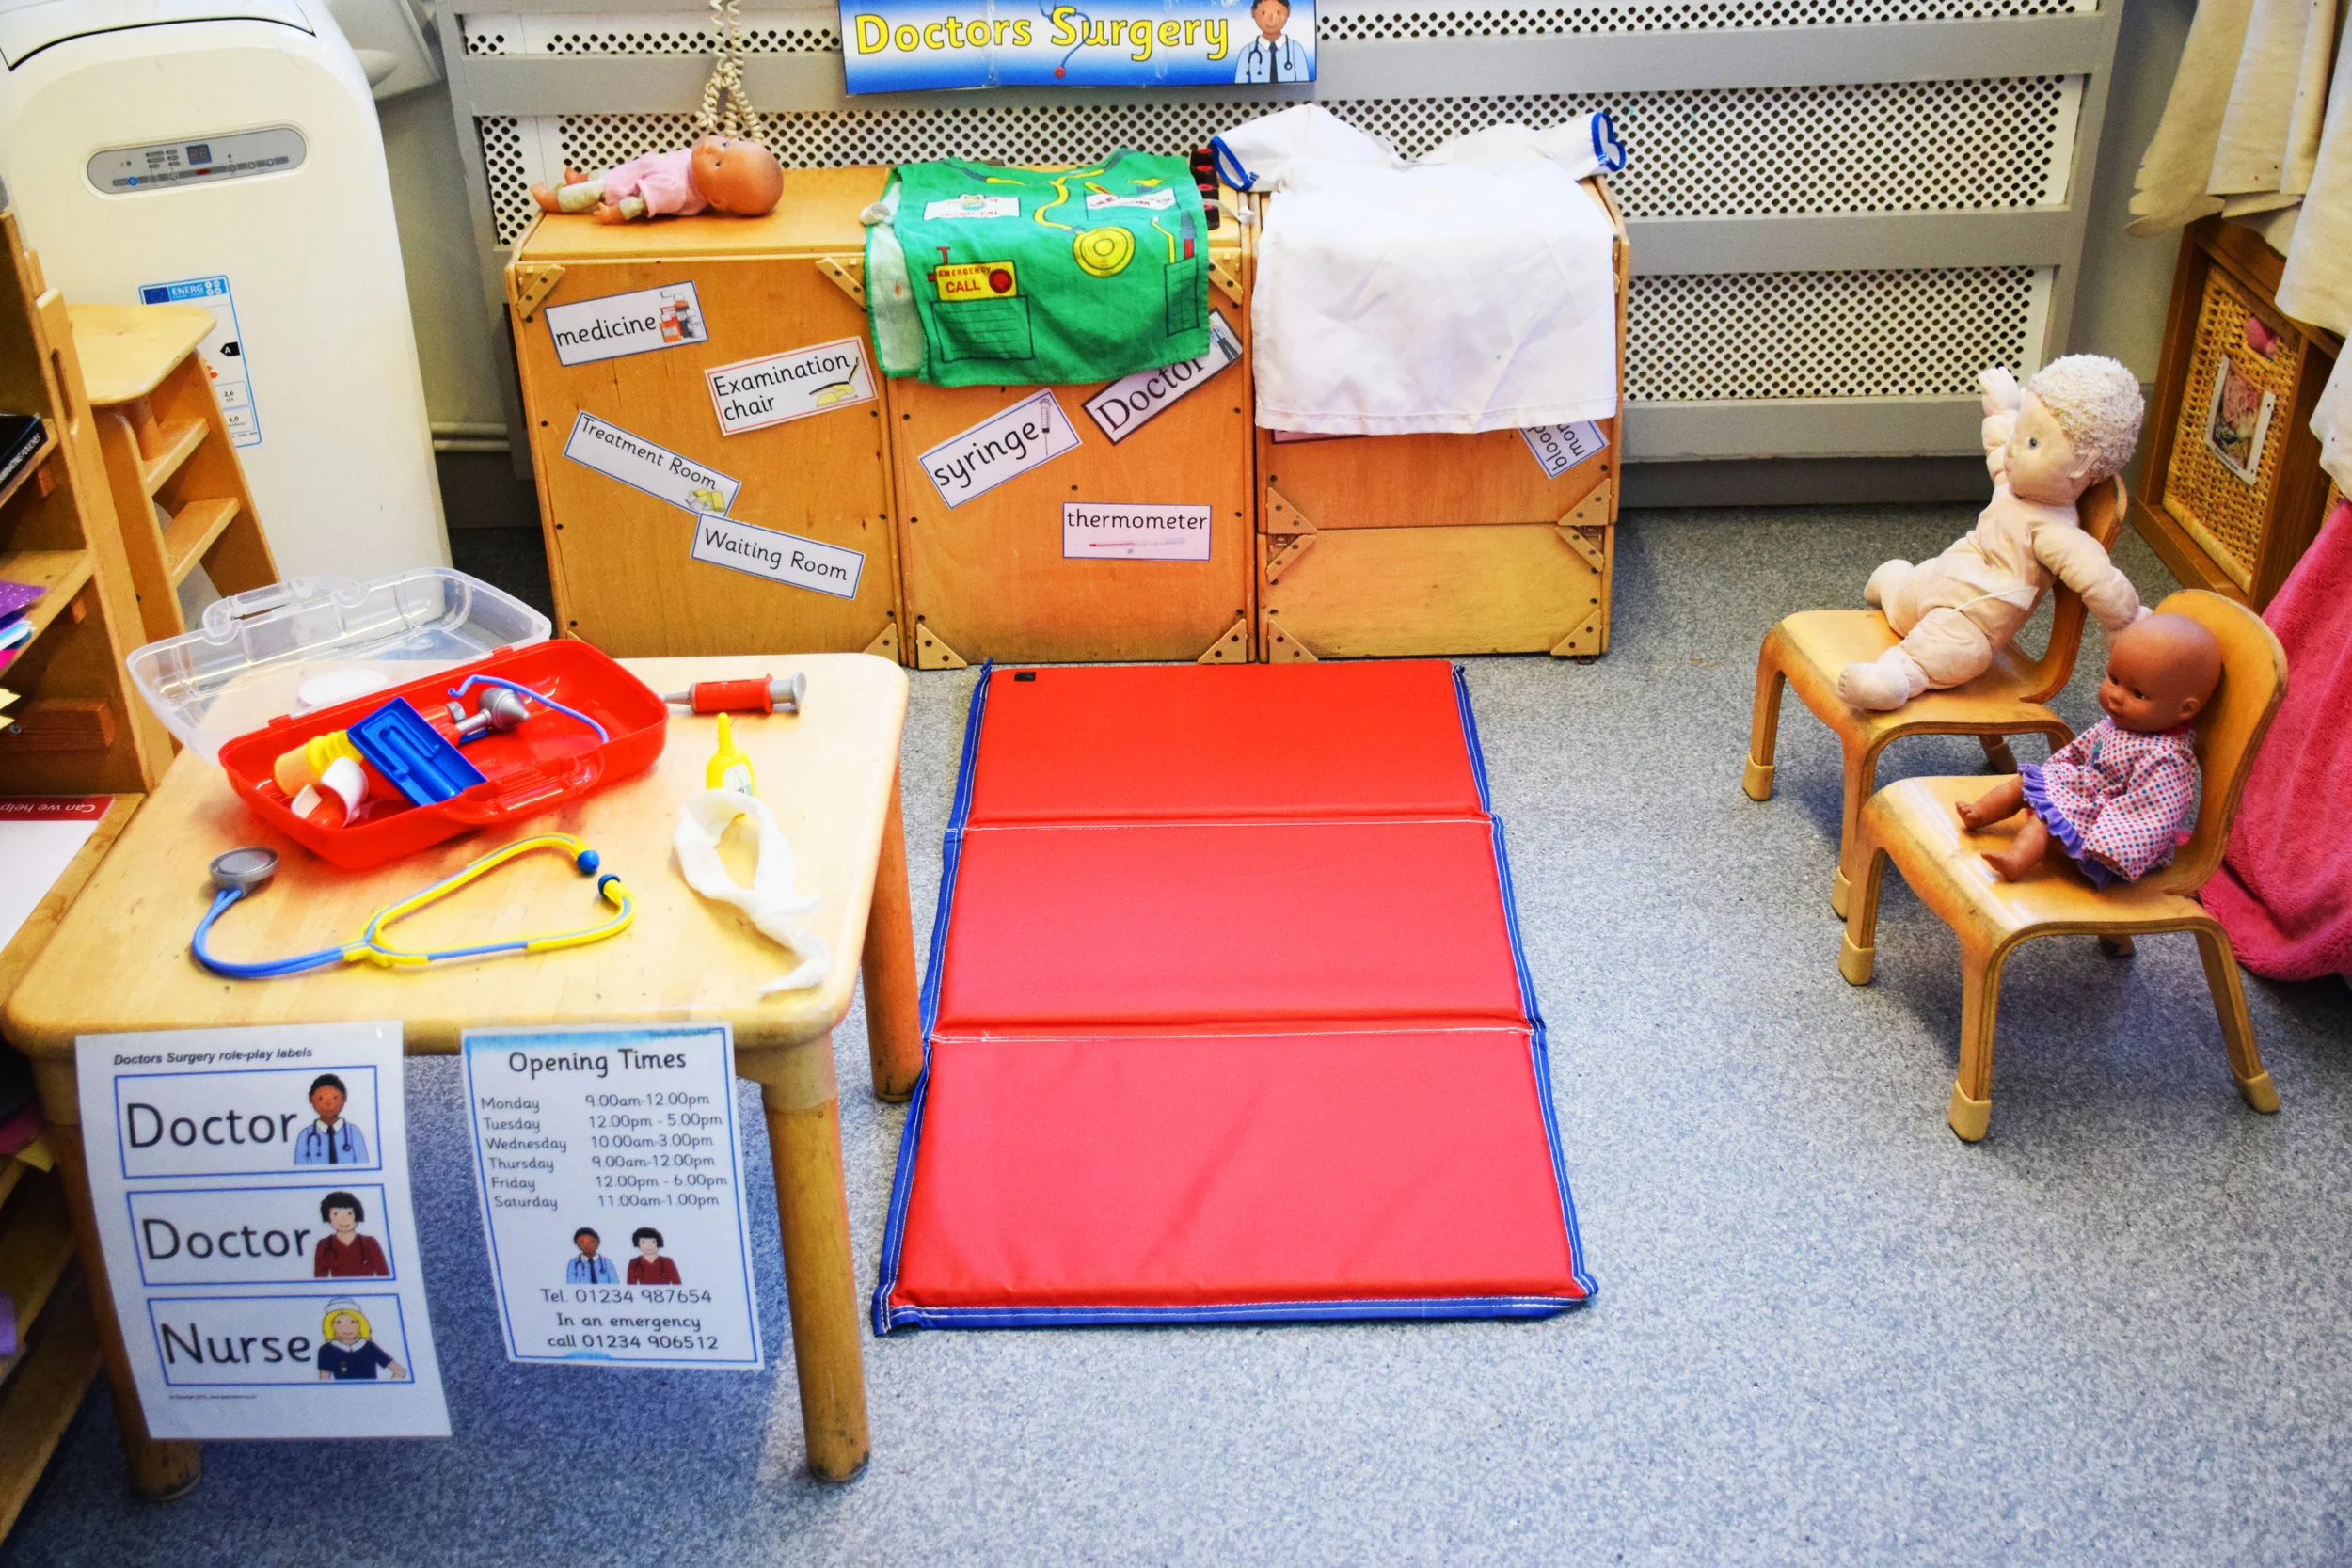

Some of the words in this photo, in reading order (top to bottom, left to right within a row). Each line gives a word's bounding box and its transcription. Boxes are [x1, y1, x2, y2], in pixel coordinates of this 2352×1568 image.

[854, 14, 1033, 55] Doctors
[1050, 6, 1229, 61] Surgery
[938, 266, 992, 277] EMERGENCY
[171, 284, 204, 296] ENERG
[946, 279, 981, 293] CALL
[556, 315, 657, 347] medicine
[224, 346, 231, 355] A
[713, 352, 850, 397] Examination
[1095, 357, 1205, 433] Doctor
[723, 394, 776, 421] chair
[580, 417, 664, 467] Treatment
[669, 456, 717, 490] Room
[934, 420, 1040, 489] syringe
[1067, 509, 1208, 531] thermometer
[705, 527, 783, 570] Waiting
[790, 550, 848, 581] Room
[65, 803, 96, 813] Can
[114, 1054, 163, 1066] Doctors
[167, 1052, 216, 1065] Surgery
[219, 1049, 274, 1062] role-play
[277, 1047, 313, 1059] labels
[509, 1051, 609, 1081] Opening
[618, 1048, 687, 1069] Times
[481, 1097, 540, 1113] Monday
[585, 1092, 710, 1110] 9.00am-12.00pm
[127, 1102, 298, 1148] Doctor
[484, 1117, 541, 1133] Tuesday
[589, 1115, 653, 1132] 12.00pm
[667, 1113, 723, 1129] 5.00pm
[486, 1136, 567, 1152] Wednesday
[591, 1134, 714, 1151] 10.00am-3.00pm
[488, 1156, 554, 1173] Thursday
[592, 1153, 715, 1172] 9.00am-12.00pm
[491, 1177, 536, 1192] Friday
[596, 1175, 659, 1191] 12.00pm
[674, 1173, 728, 1190] 6.00pm
[494, 1195, 558, 1212] Saturday
[598, 1193, 720, 1210] 11.00am-1.00pm
[142, 1218, 311, 1259] Doctor
[540, 1288, 568, 1303] Tel.
[575, 1289, 634, 1303] 01234
[641, 1289, 712, 1304] 987654
[557, 1312, 575, 1326] In
[581, 1316, 603, 1327] an
[610, 1316, 701, 1332] emergency
[161, 1322, 311, 1364] Nurse
[548, 1334, 577, 1348] call
[581, 1334, 641, 1348] 01234
[647, 1335, 719, 1350] 906512
